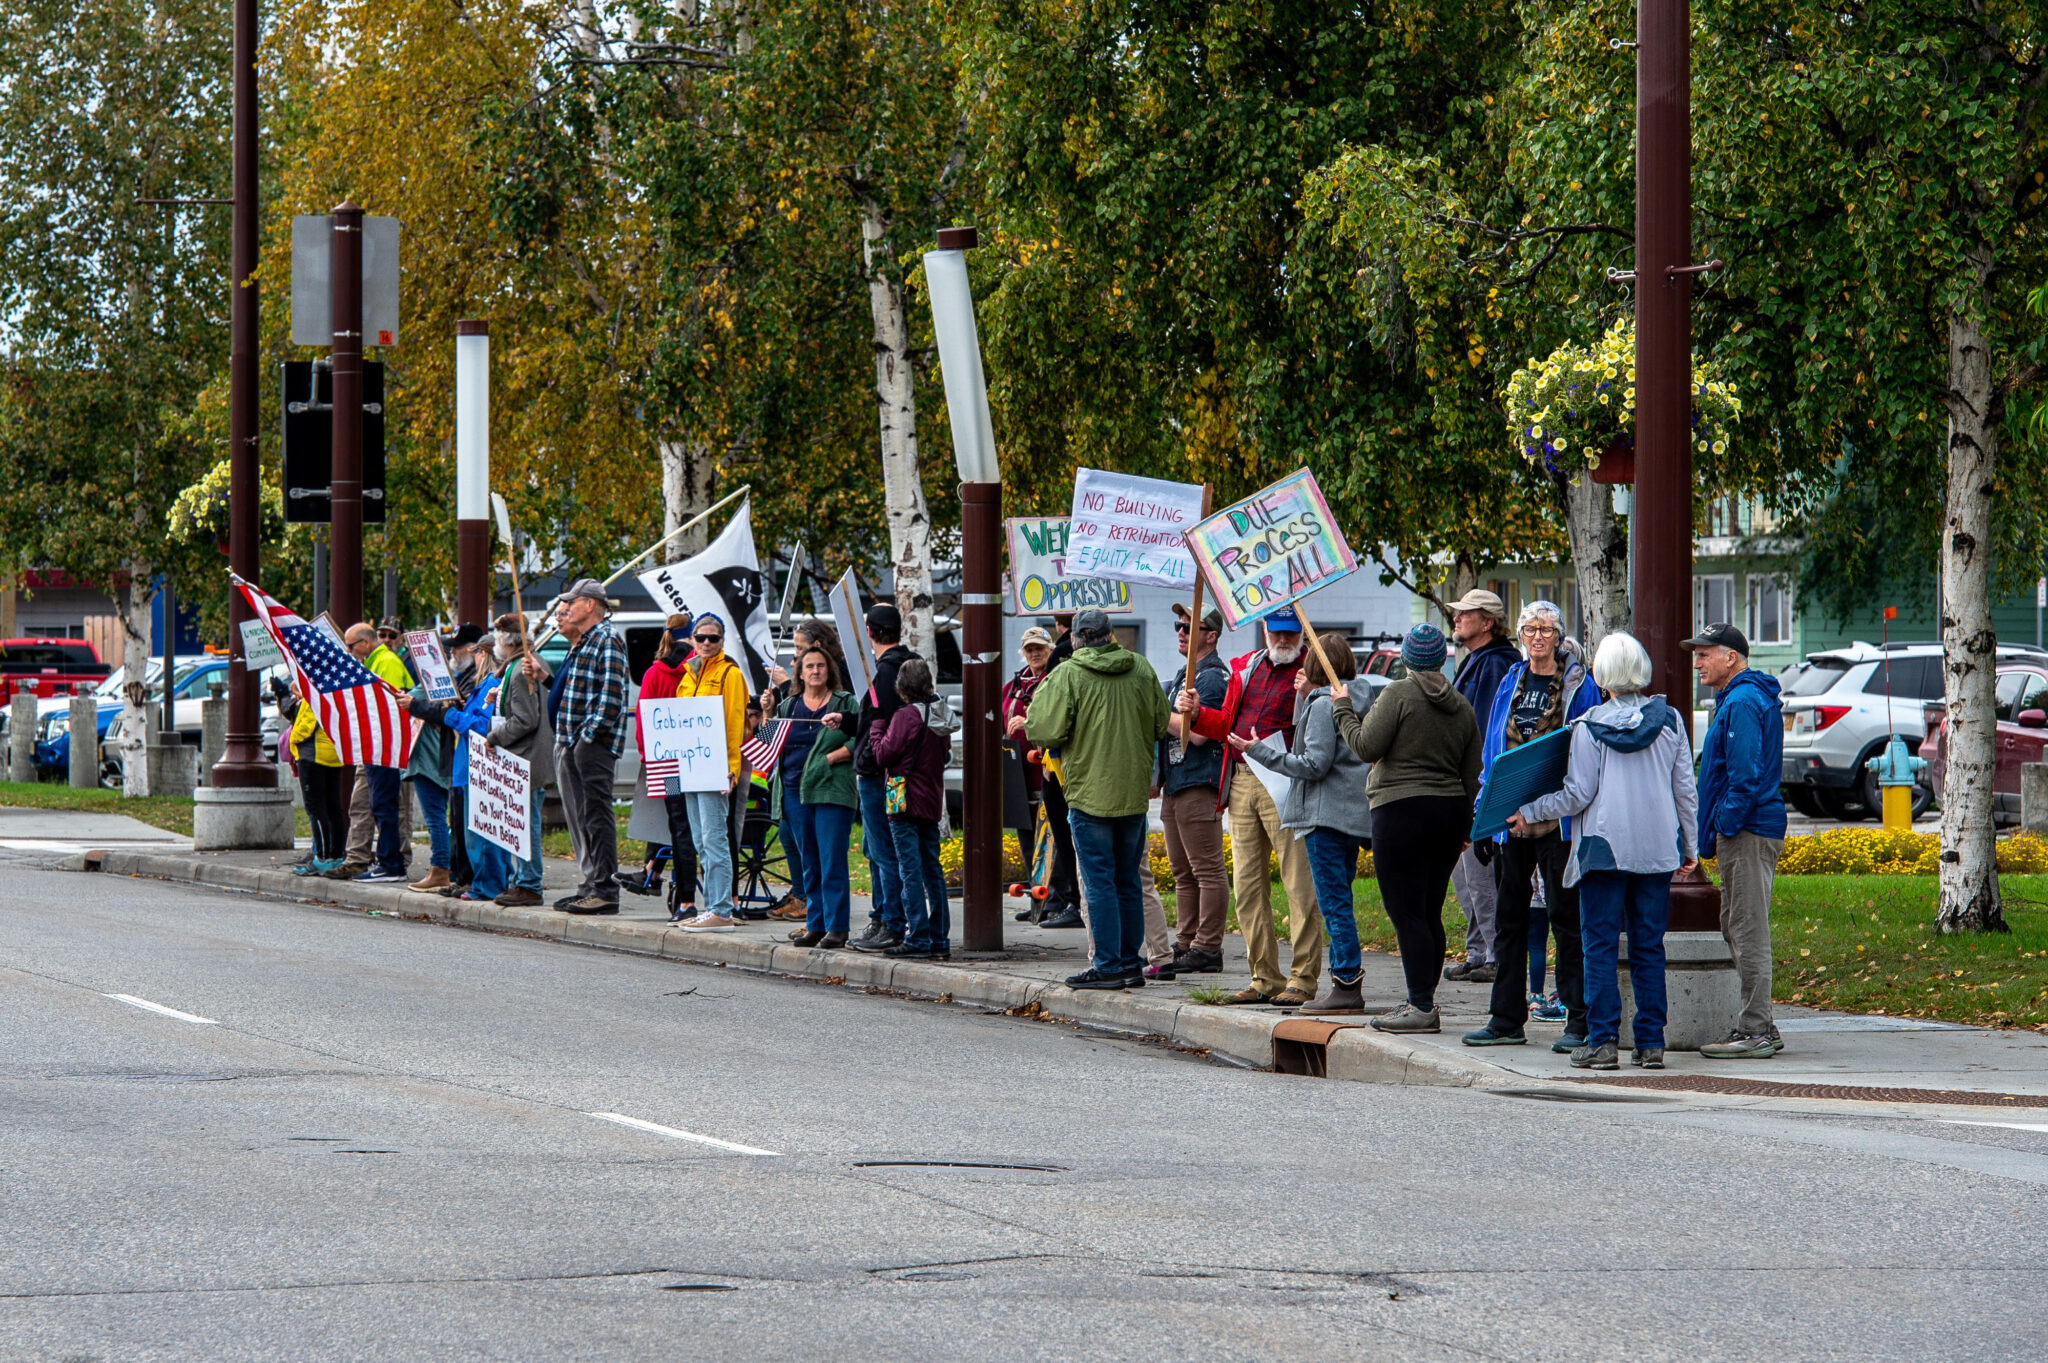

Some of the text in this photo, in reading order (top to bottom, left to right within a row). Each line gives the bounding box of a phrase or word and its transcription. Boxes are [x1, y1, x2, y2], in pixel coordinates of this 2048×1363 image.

[1082, 492, 1183, 523] NO BULLYING
[1226, 493, 1292, 538] DUE
[1076, 521, 1098, 536] NO
[1051, 559, 1066, 577] T
[1158, 557, 1185, 579] ALL
[1232, 543, 1338, 613] FOR ALL
[656, 570, 696, 620] Vetera
[1020, 574, 1130, 612] OPPRESSED
[408, 633, 431, 645] RESIST
[249, 646, 281, 659] COMMUNIT
[412, 646, 427, 657] EVIL
[434, 676, 451, 687] STOP
[428, 687, 457, 699] FASCISM
[653, 706, 713, 730] Gobierno
[654, 736, 711, 773] Corrupto
